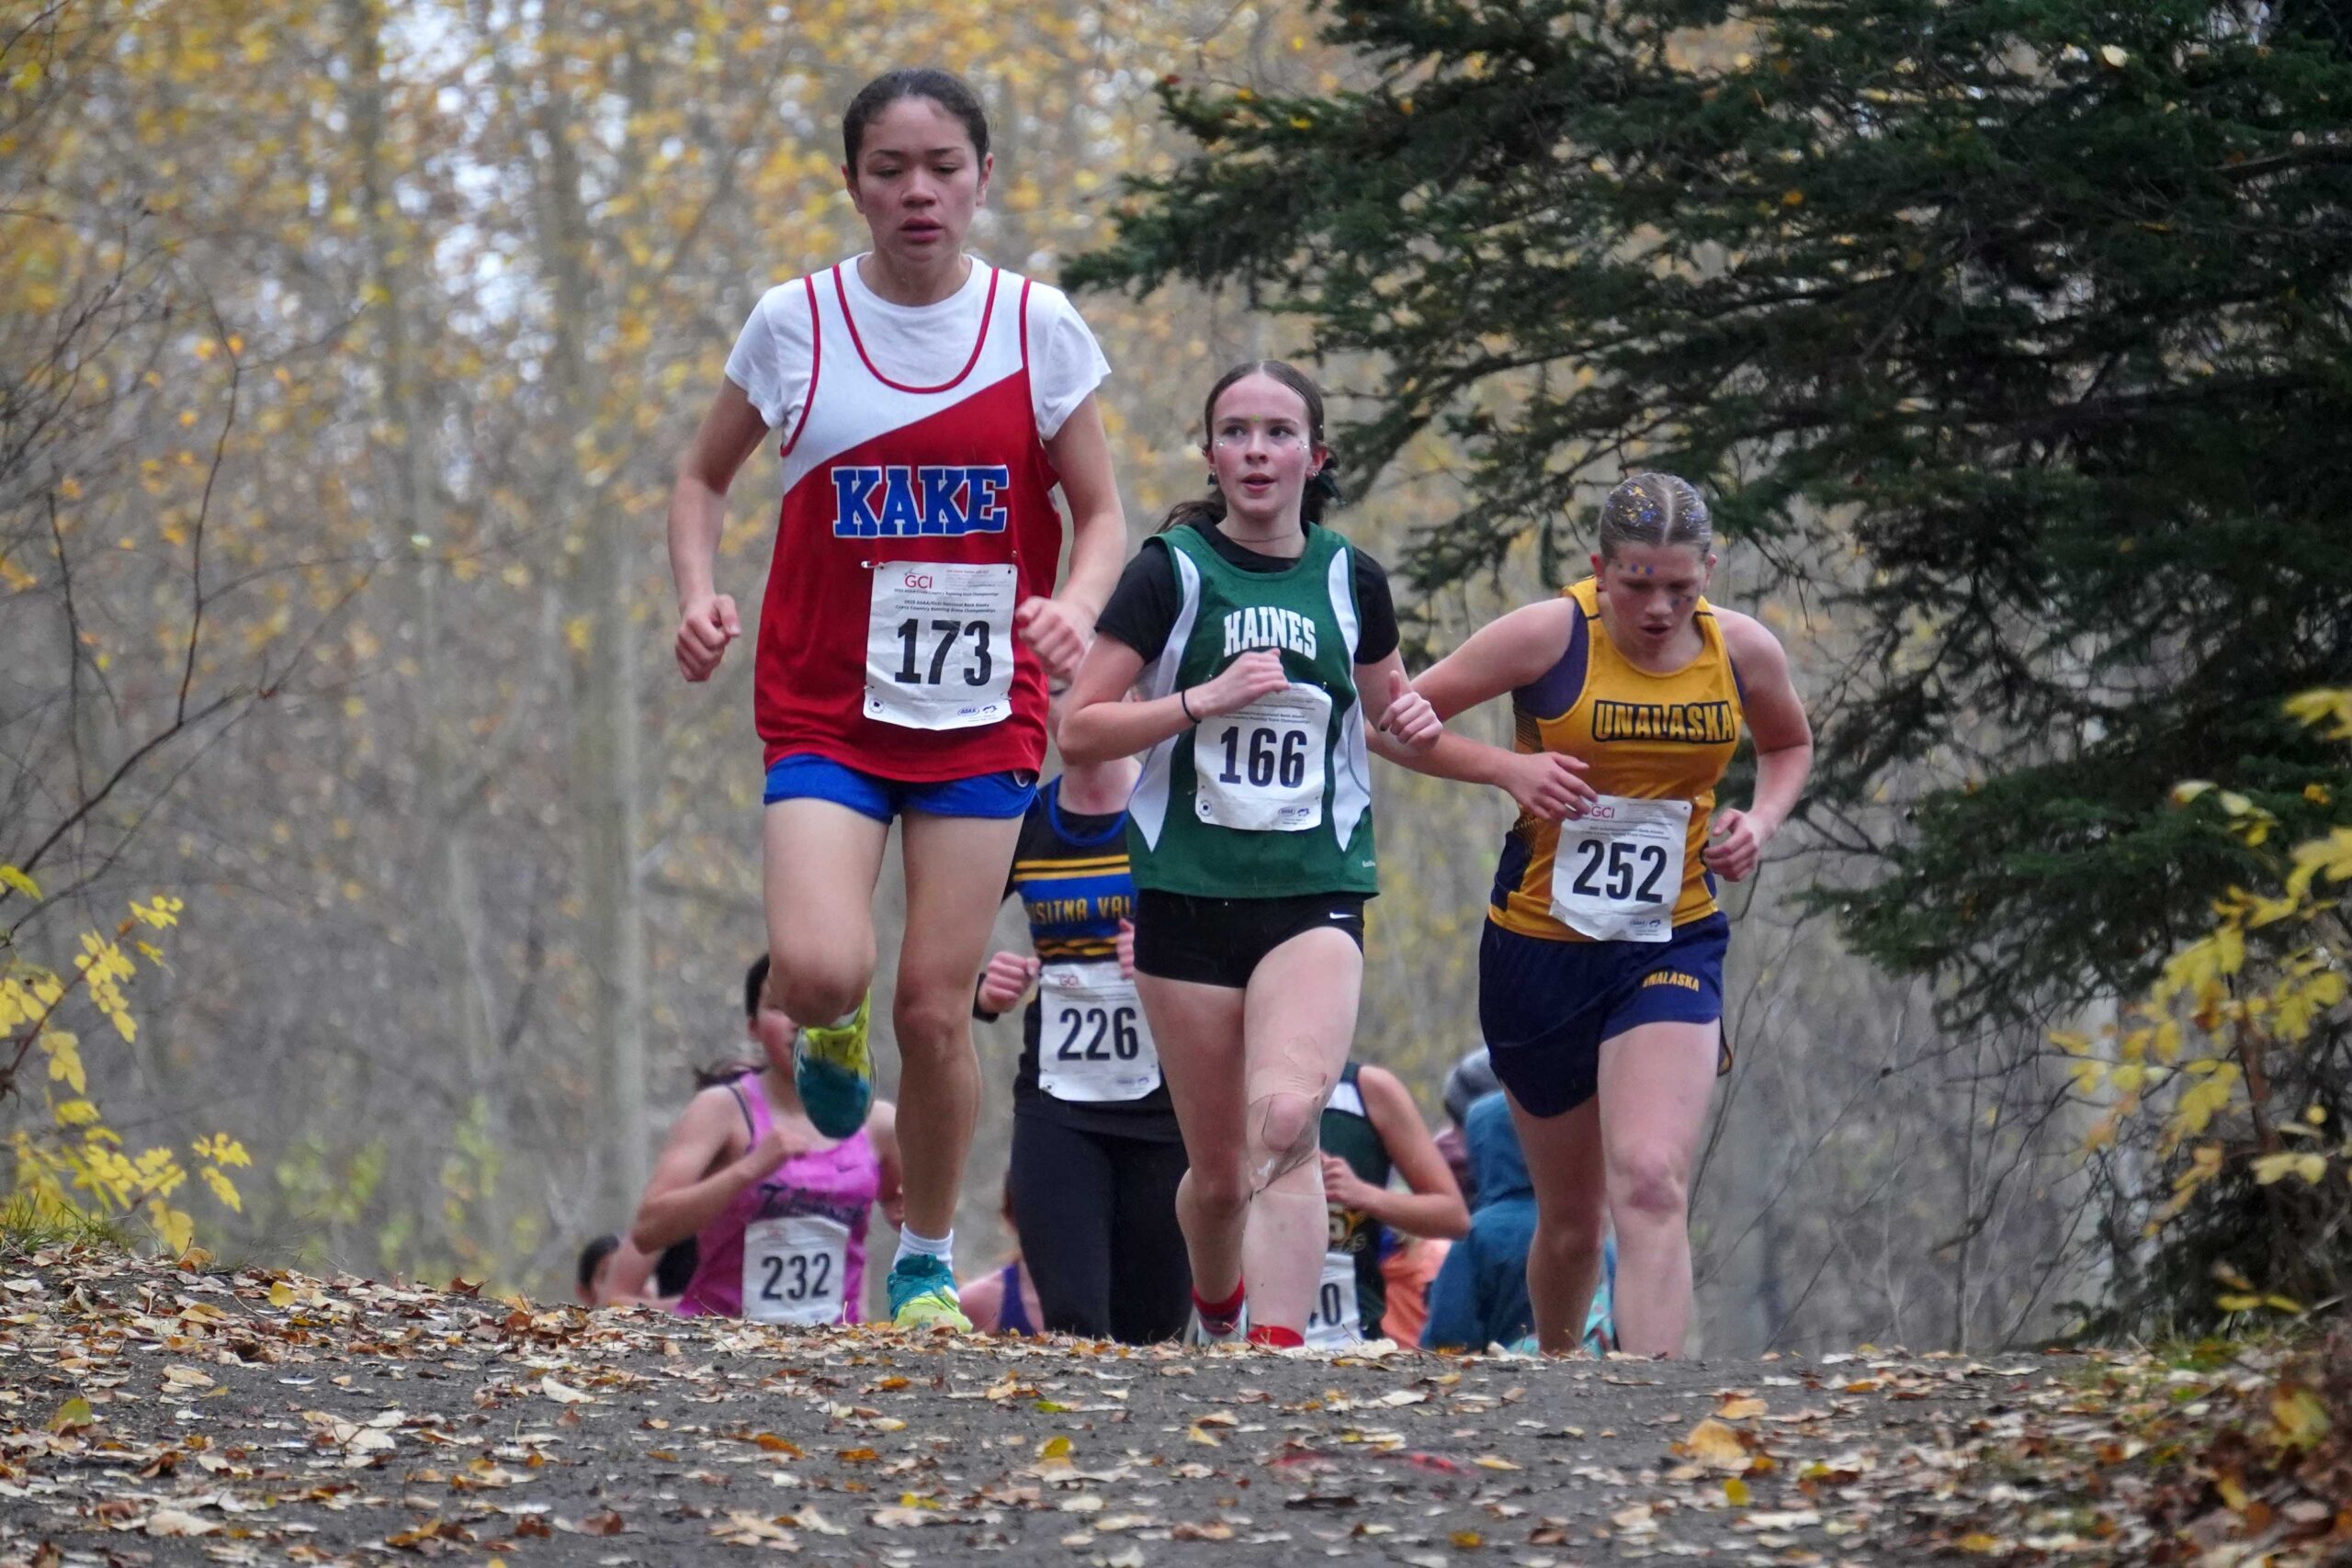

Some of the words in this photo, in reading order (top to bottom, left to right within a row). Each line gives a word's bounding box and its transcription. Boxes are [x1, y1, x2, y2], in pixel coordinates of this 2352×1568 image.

[831, 464, 1009, 538] KAKE
[905, 574, 933, 589] GCI
[894, 618, 992, 686] 173
[1224, 606, 1317, 661] HAINES
[1593, 701, 1735, 742] UNALASKA
[1219, 727, 1307, 788] 166
[1591, 806, 1615, 818] GCI
[1572, 839, 1668, 903] 252
[1028, 898, 1088, 924] SITNA
[1057, 1008, 1138, 1061] 226
[761, 1252, 831, 1301] 232
